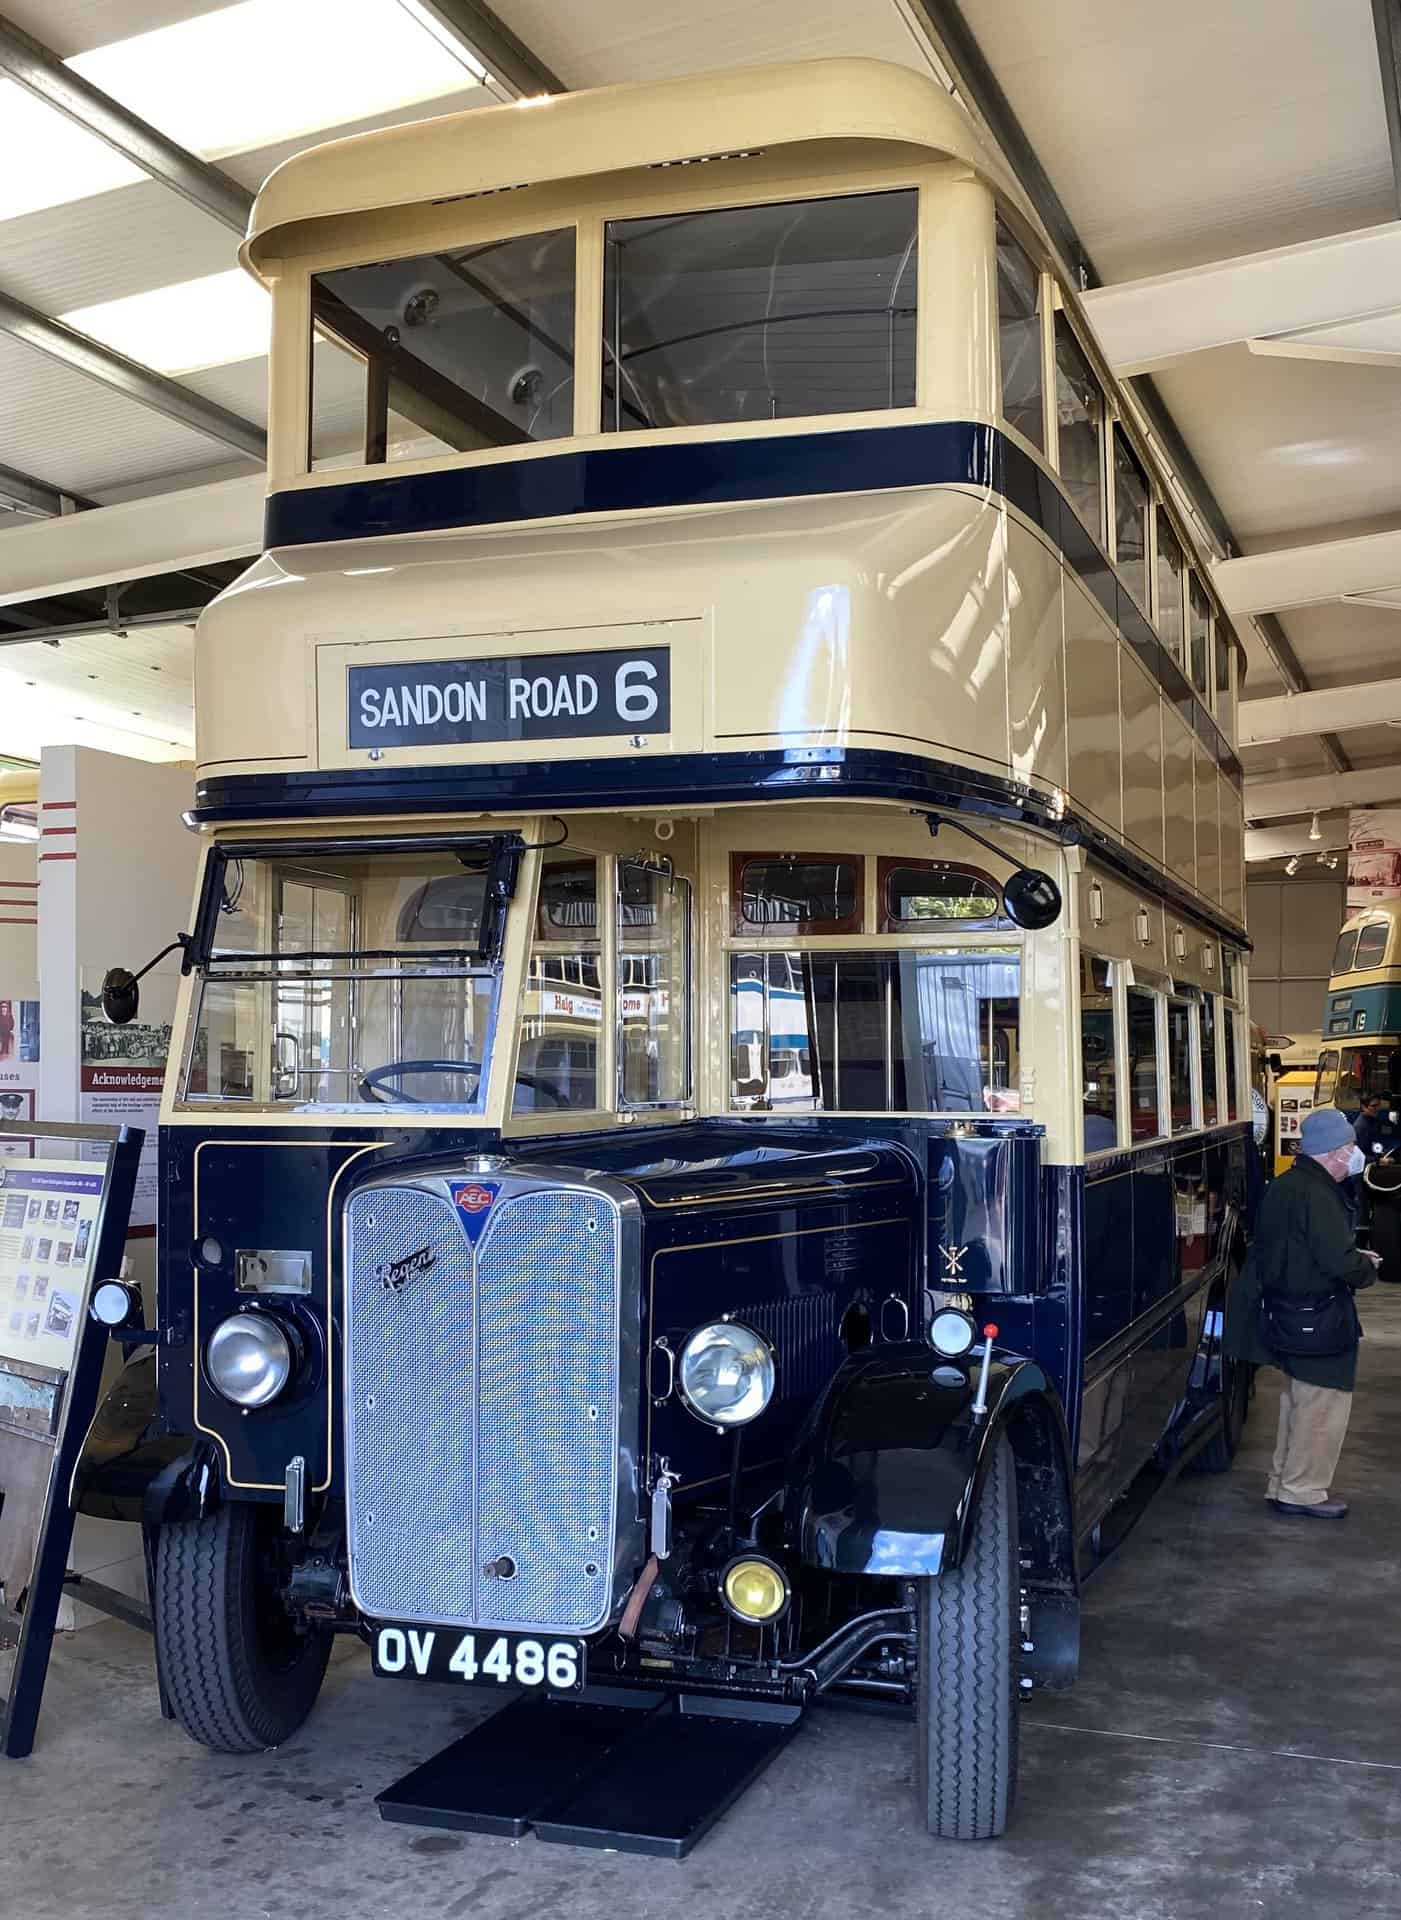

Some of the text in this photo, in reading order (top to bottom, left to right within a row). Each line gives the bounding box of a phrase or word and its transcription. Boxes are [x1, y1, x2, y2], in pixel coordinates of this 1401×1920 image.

[360, 659, 658, 729] SANDON ROAD 6
[554, 993, 574, 1014] Haig
[1355, 1013, 1367, 1031] 19
[458, 1192, 489, 1205] AEC
[377, 1627, 579, 1689] OV 4486
